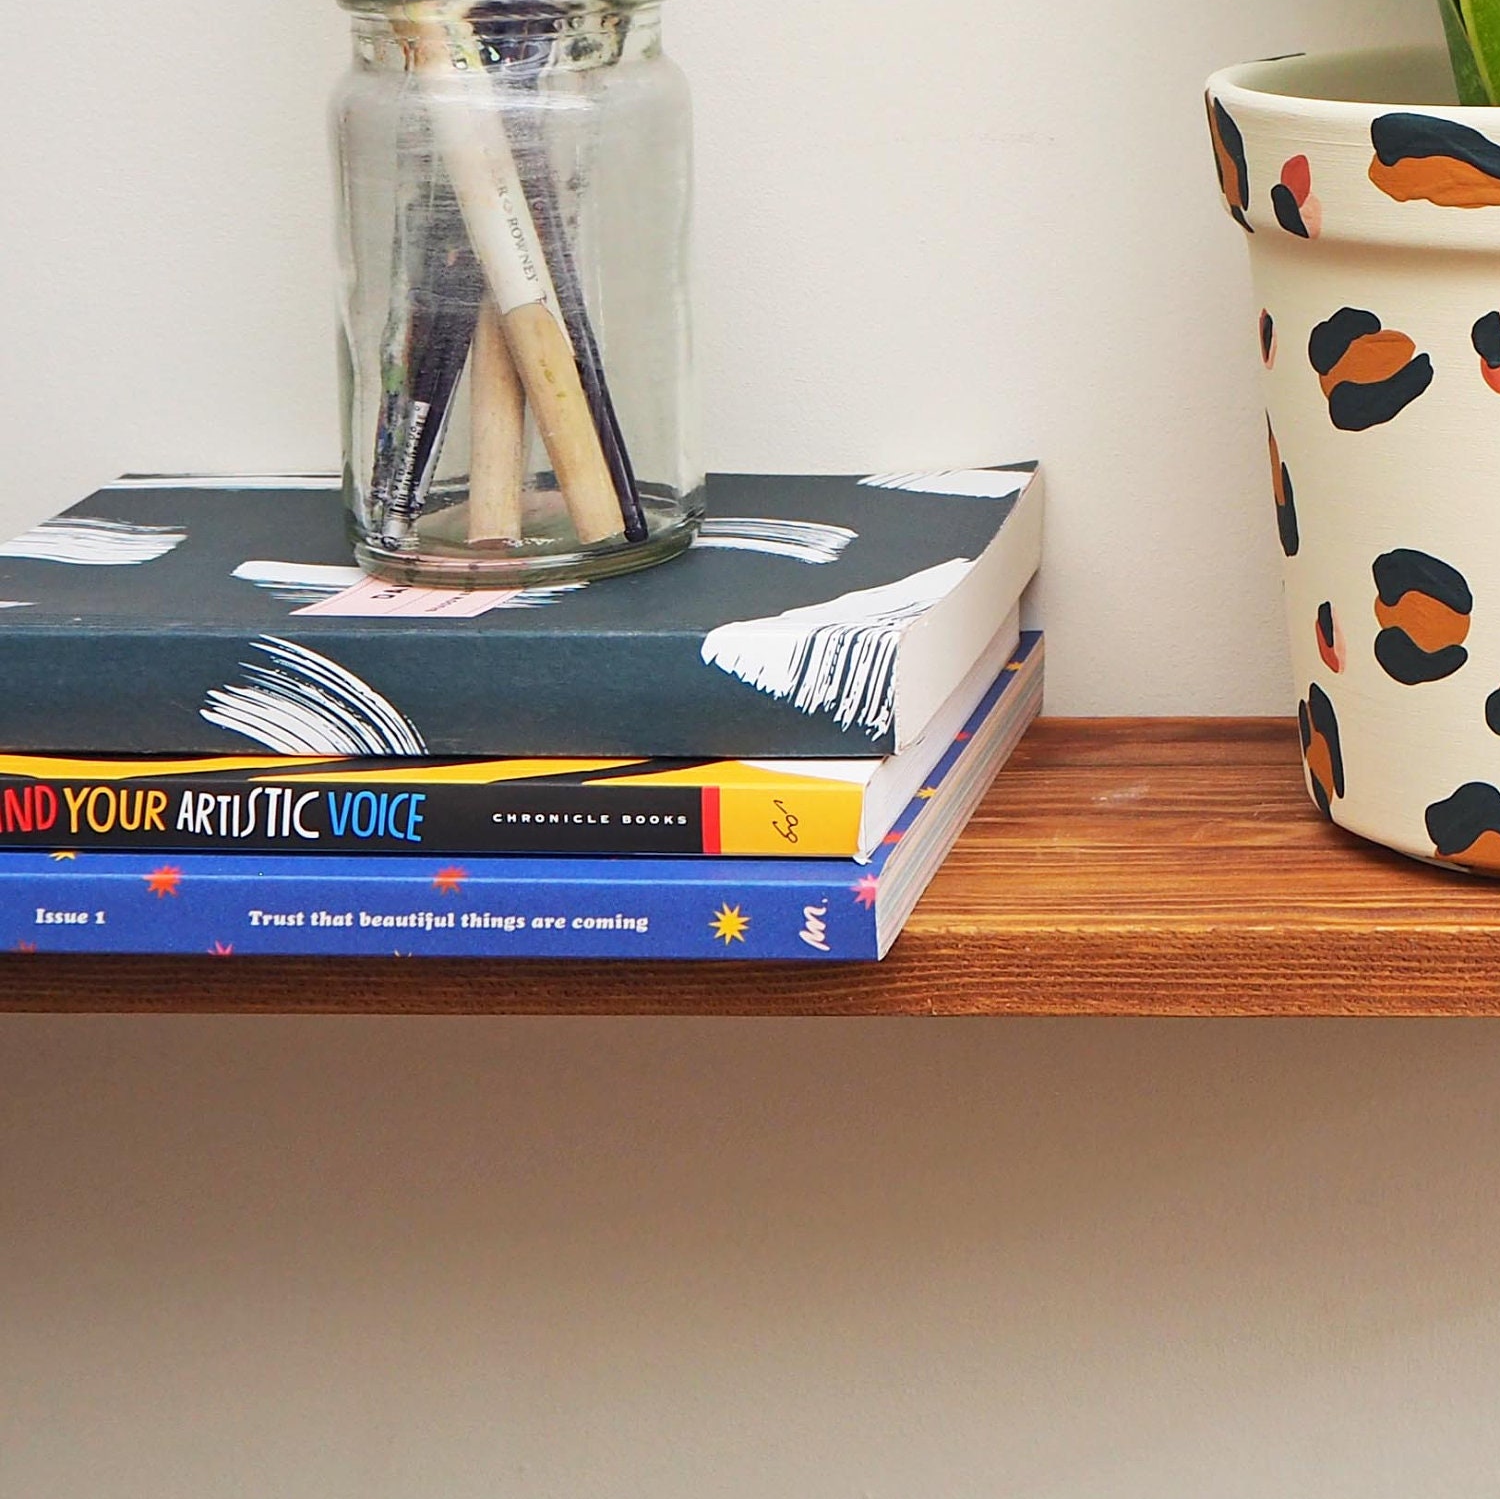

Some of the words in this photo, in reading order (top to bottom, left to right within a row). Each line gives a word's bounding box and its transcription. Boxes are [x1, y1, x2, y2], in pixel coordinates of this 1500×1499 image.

[507, 217, 539, 282] ROWNEY
[62, 786, 168, 833] YOUR
[176, 786, 320, 839] ARTISTIC
[327, 790, 426, 842] VOICE
[492, 813, 610, 824] CHRONICLE
[622, 814, 687, 825] BOOKS
[35, 907, 89, 925] Issue
[95, 910, 106, 925] 1
[248, 910, 305, 927] Trust
[310, 910, 353, 927] that
[358, 911, 455, 931] beautiful
[460, 912, 526, 932] things
[530, 916, 567, 929] are
[571, 913, 649, 933] coming
